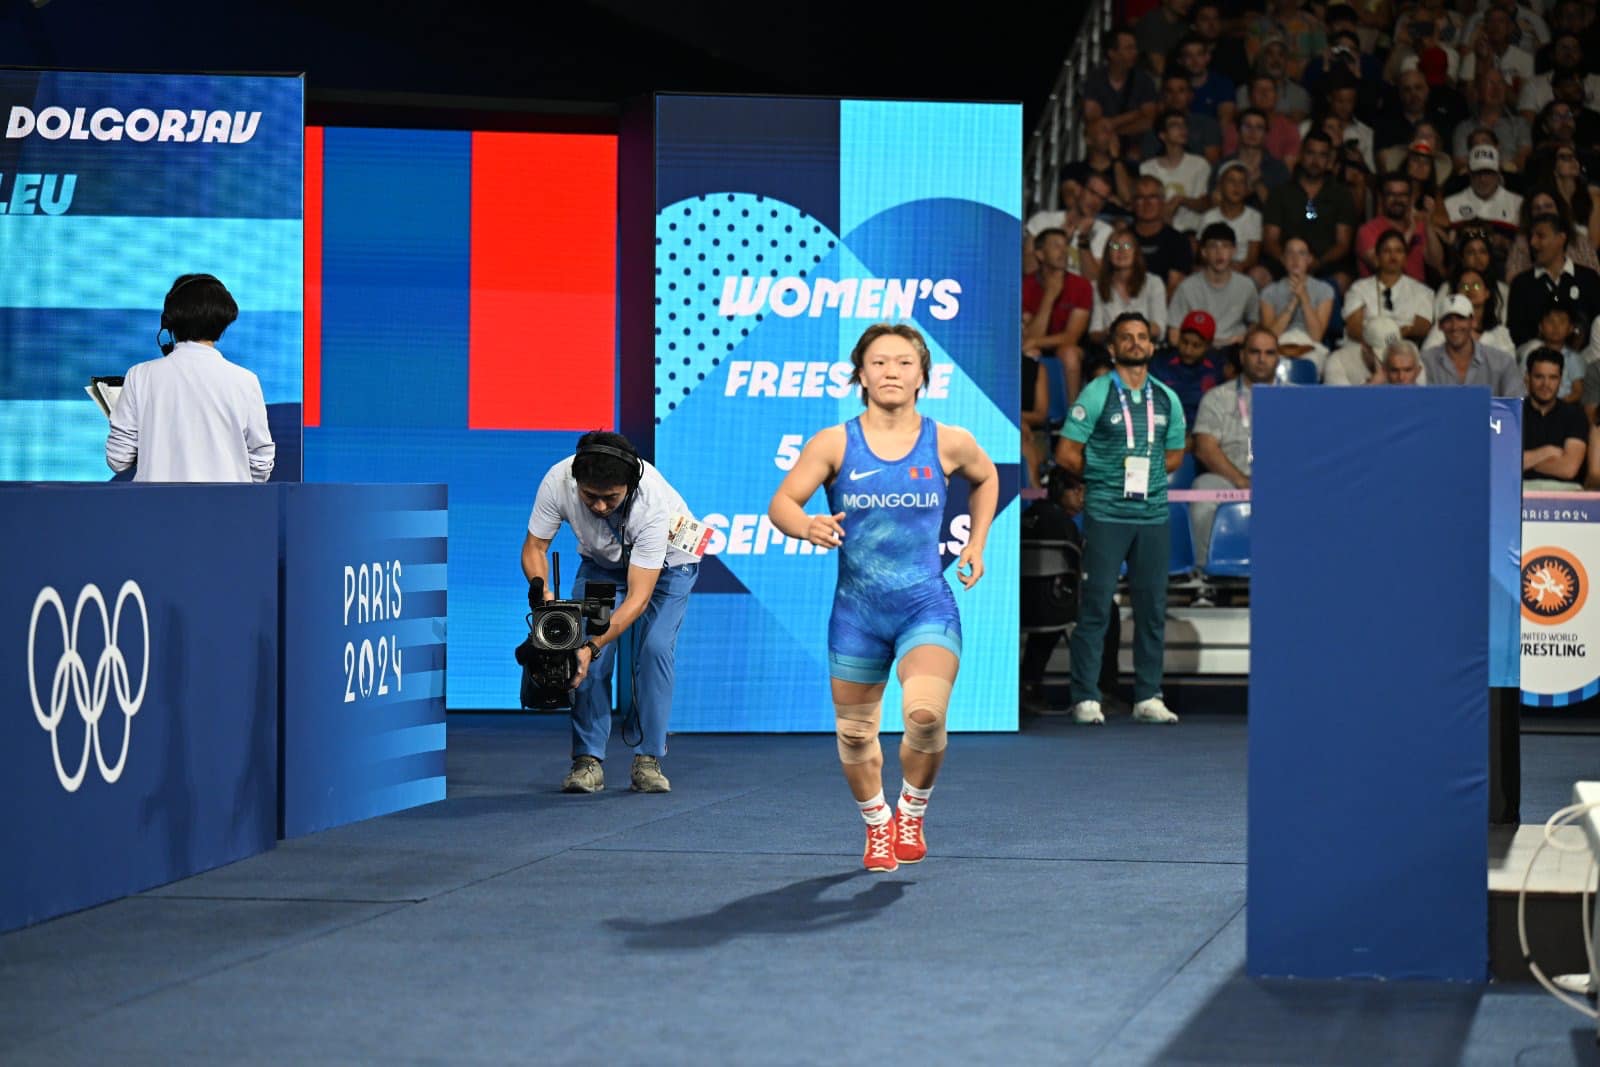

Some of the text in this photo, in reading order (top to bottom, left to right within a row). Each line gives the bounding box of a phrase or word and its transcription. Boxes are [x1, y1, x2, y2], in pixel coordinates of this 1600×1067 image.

[5, 105, 262, 144] DOLGORJAV
[718, 275, 962, 321] WOMEN'S
[724, 361, 954, 399] FREESE
[842, 493, 940, 509] MONGOLIA
[1554, 509, 1588, 521] 2024
[1548, 632, 1578, 642] WORLD
[343, 634, 402, 703] 2024
